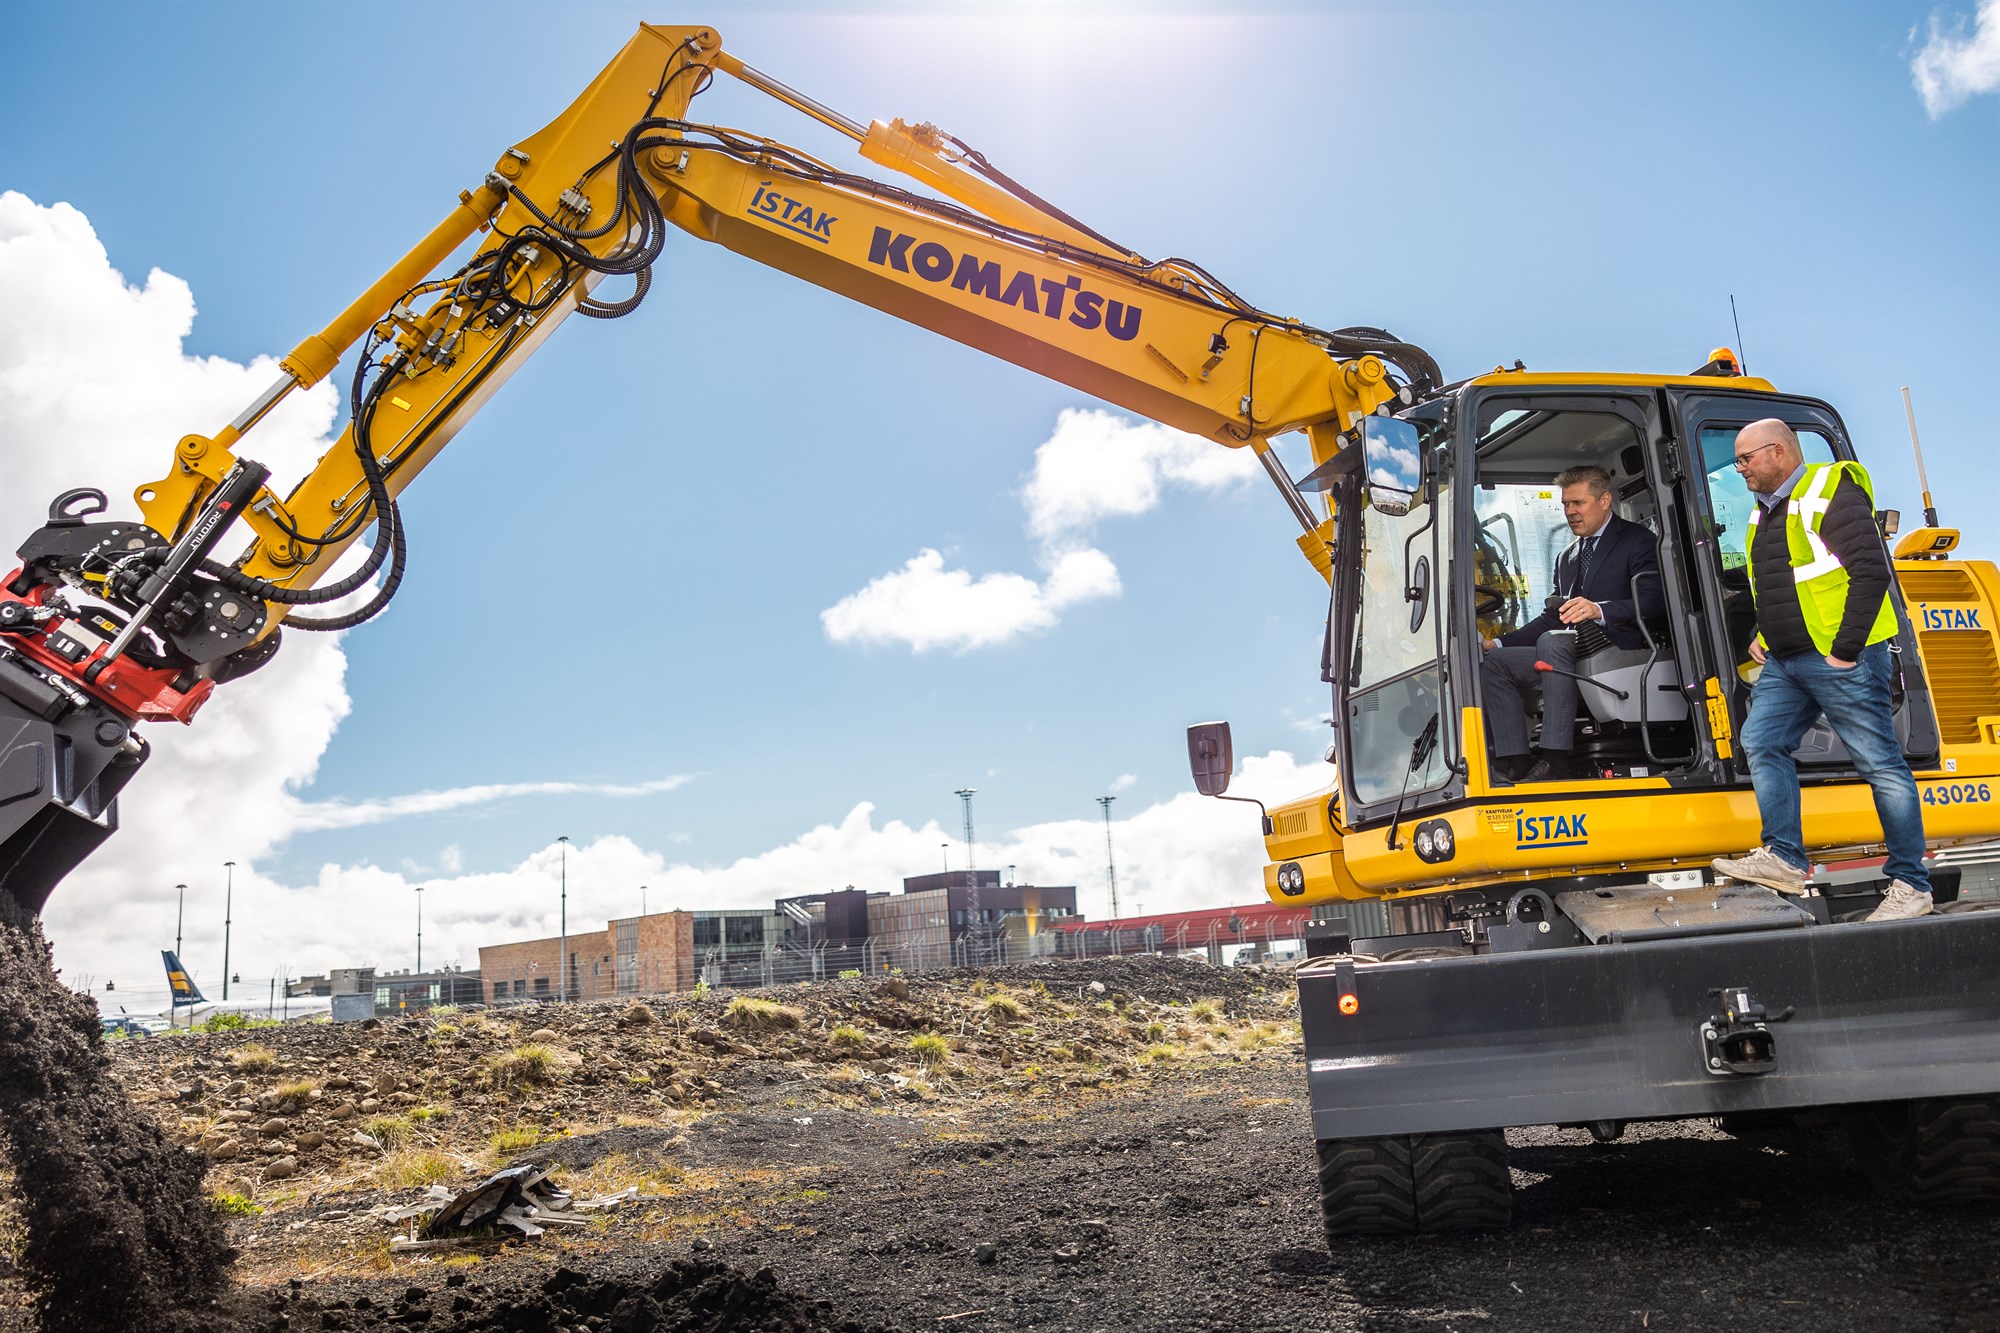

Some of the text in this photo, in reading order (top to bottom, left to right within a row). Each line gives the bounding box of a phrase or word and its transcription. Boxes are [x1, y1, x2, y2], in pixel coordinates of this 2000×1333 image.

[750, 181, 839, 237] ÍSTAK
[867, 225, 1143, 342] KOMATSU
[189, 510, 222, 550] ROTOTILT
[1919, 602, 1982, 629] ÍSTAK
[1923, 783, 1991, 806] 43026
[1515, 808, 1588, 842] ÍSTAK
